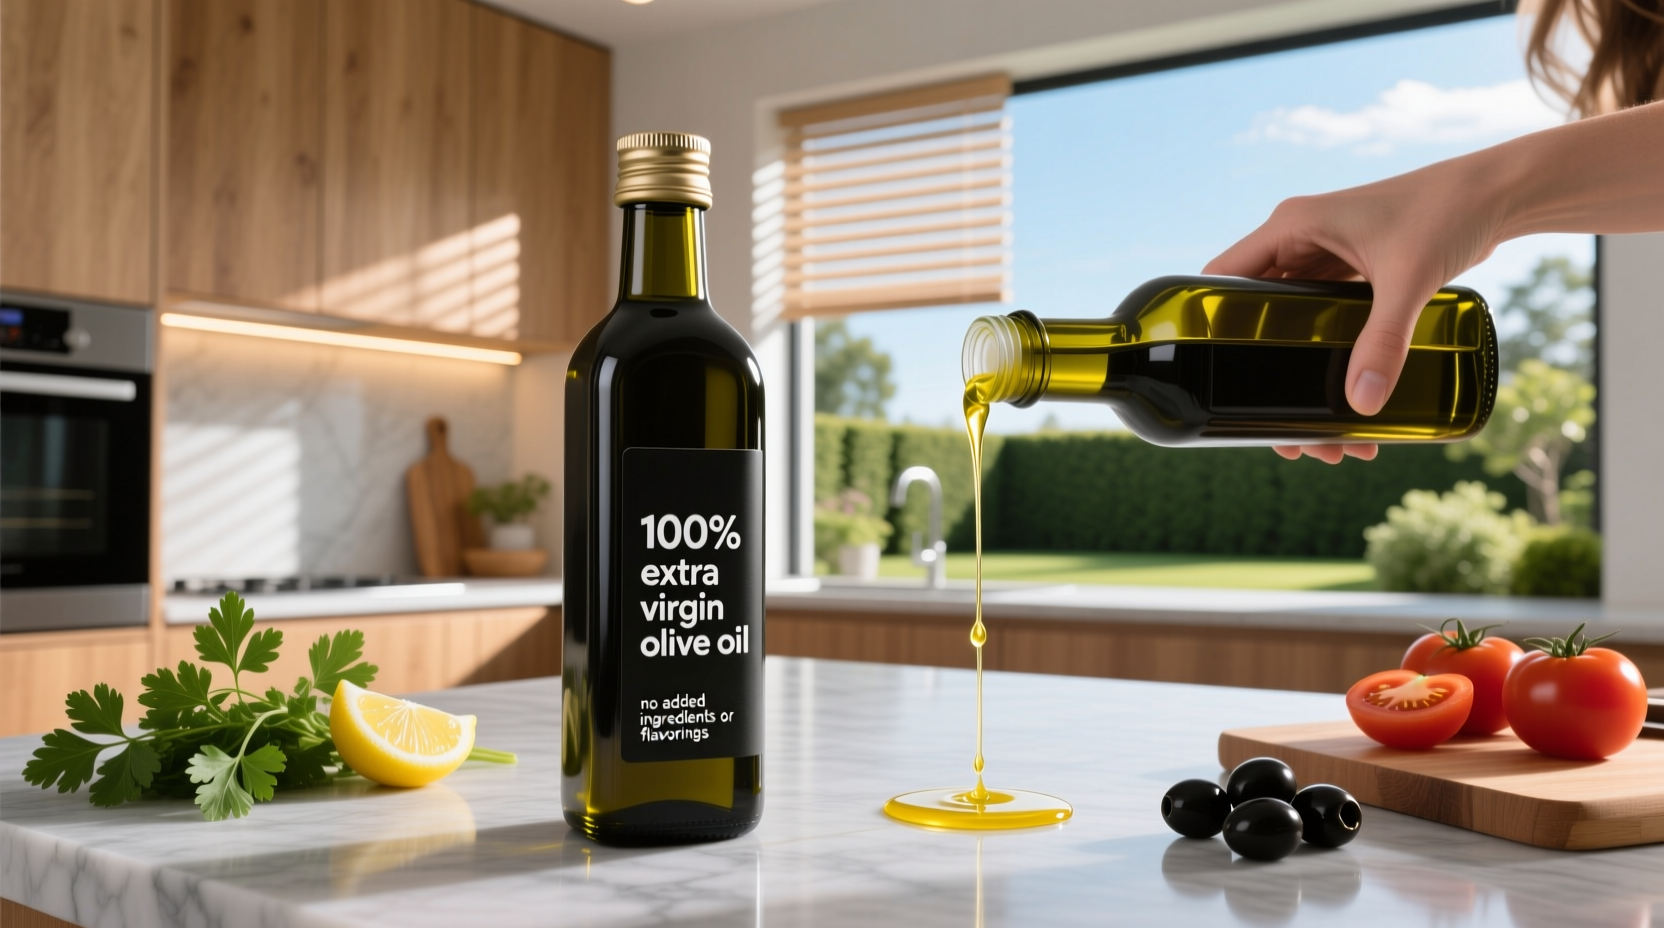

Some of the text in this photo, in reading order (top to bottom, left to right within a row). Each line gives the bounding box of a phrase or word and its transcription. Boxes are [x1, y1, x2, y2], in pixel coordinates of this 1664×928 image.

[640, 514, 742, 550] 100%
[640, 559, 719, 586] extra
[640, 592, 724, 629] virgin
[640, 625, 749, 657] olive oil
[641, 693, 706, 710] no added
[640, 709, 735, 729] ingredients or
[640, 726, 710, 743] flavorings
